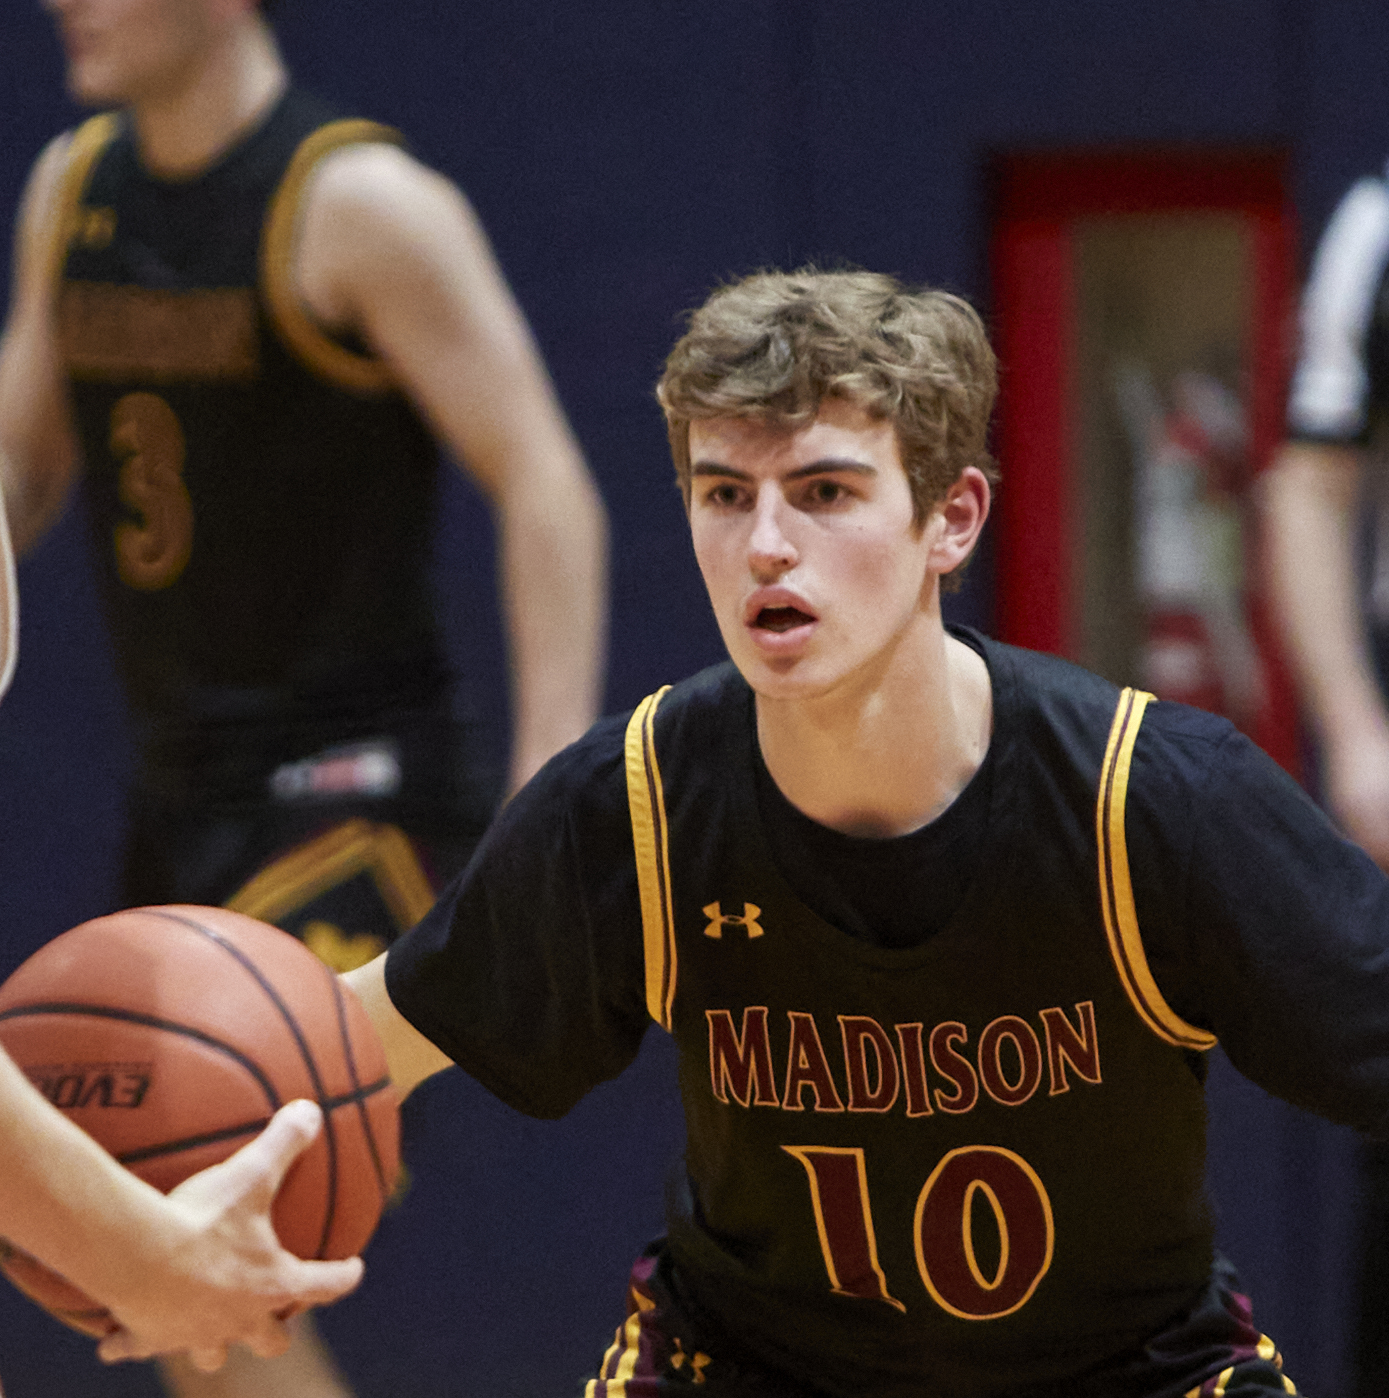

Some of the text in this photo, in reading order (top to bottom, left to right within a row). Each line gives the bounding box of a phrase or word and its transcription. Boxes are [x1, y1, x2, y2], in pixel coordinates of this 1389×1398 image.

[109, 391, 194, 590] 3
[705, 1001, 1102, 1117] MADISON
[779, 1145, 1055, 1320] 10
